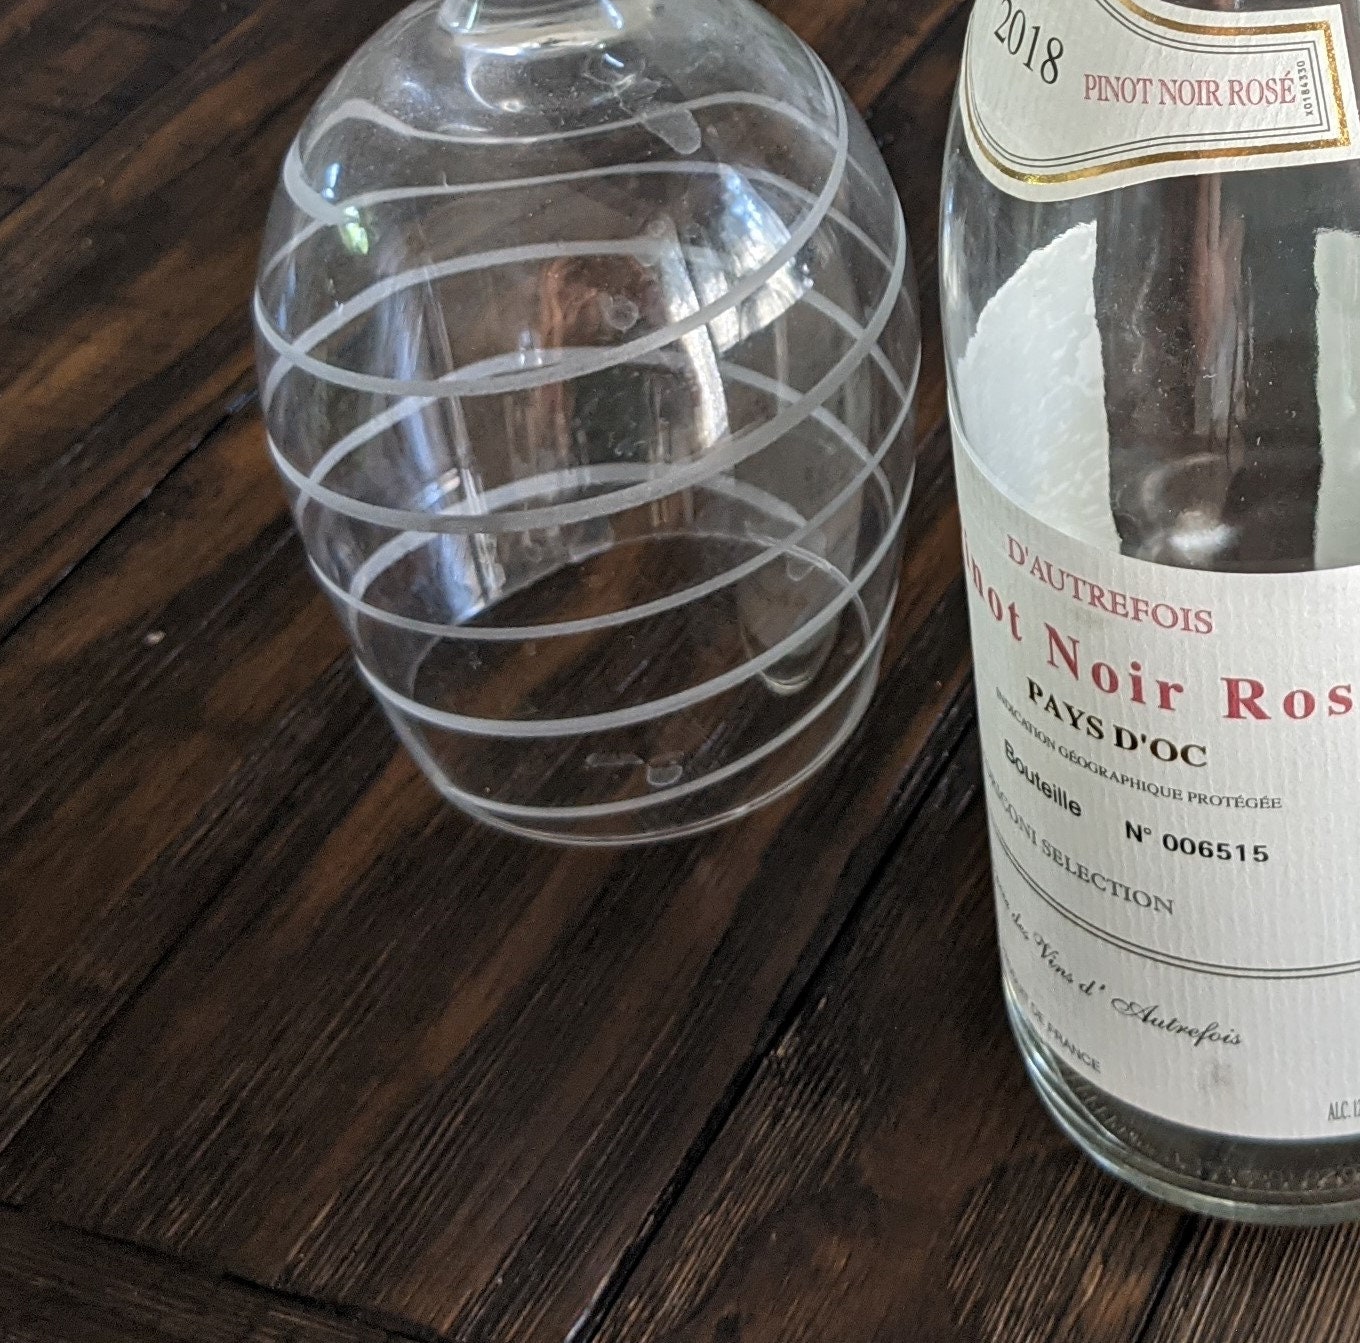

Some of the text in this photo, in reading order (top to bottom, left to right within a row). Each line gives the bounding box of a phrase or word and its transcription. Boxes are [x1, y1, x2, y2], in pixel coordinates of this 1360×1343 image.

[1083, 70, 1297, 108] PINOT NOIR ROSÉ
[1007, 534, 1215, 636] D'AUTREFOIS
[1044, 622, 1184, 711] Noir
[995, 685, 1283, 810] INDICATION GÉOGRAPHIQUE PROTÉGÉE
[1027, 676, 1209, 768] PAYS D'OC
[1004, 738, 1083, 817] Bouteille
[1041, 838, 1175, 916] SELECTION
[1162, 832, 1270, 863] 006515
[1033, 931, 1075, 984] Vins
[1110, 997, 1242, 1047] Autrefois
[1047, 1021, 1102, 1074] FRANCE
[1327, 1100, 1352, 1122] ALC.
